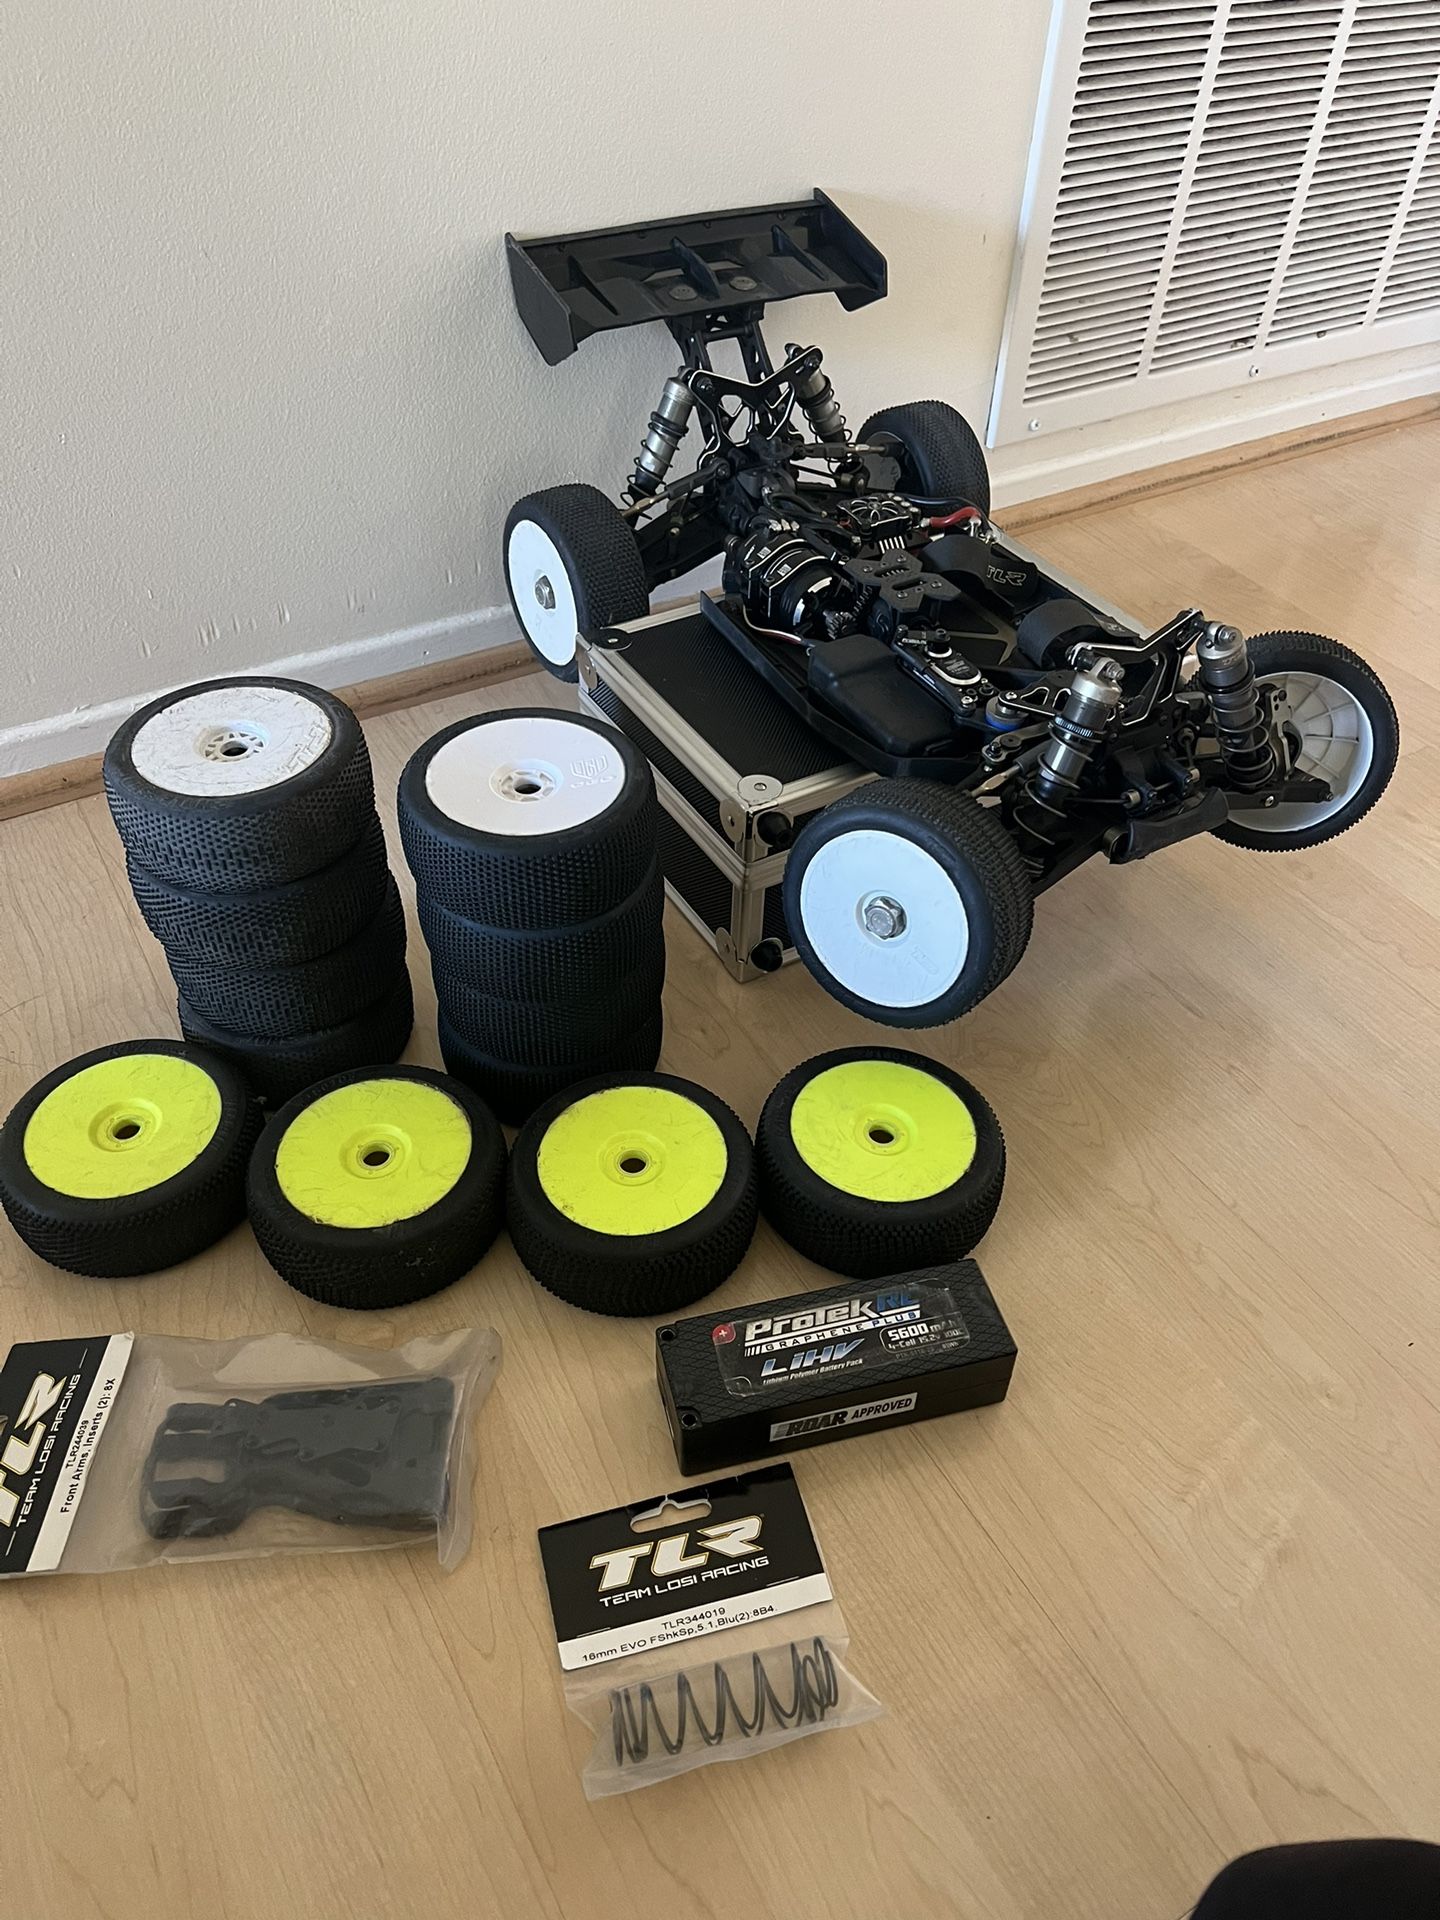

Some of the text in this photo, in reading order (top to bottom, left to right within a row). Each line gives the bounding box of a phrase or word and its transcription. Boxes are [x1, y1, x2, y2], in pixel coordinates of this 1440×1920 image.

[765, 1311, 917, 1351] GRAPHENE PLUS
[888, 1338, 916, 1349] 4-Cell
[760, 1337, 865, 1376] LiHV
[763, 1358, 863, 1385] Lithium Polymer Battery Pack
[785, 1398, 913, 1436] ROAR APPROVED
[17, 1374, 81, 1528] TEAM LOSI RACING
[60, 1483, 79, 1513] Front
[83, 1412, 103, 1447] Inserts
[104, 1378, 116, 1391] 8X
[65, 1420, 89, 1469] TLR244039
[589, 1515, 764, 1592] TLR
[600, 1556, 769, 1607] TEAM LOSI RACING
[662, 1607, 726, 1630] TLR344019
[583, 1648, 617, 1662] 16mm
[620, 1639, 647, 1652] EVO
